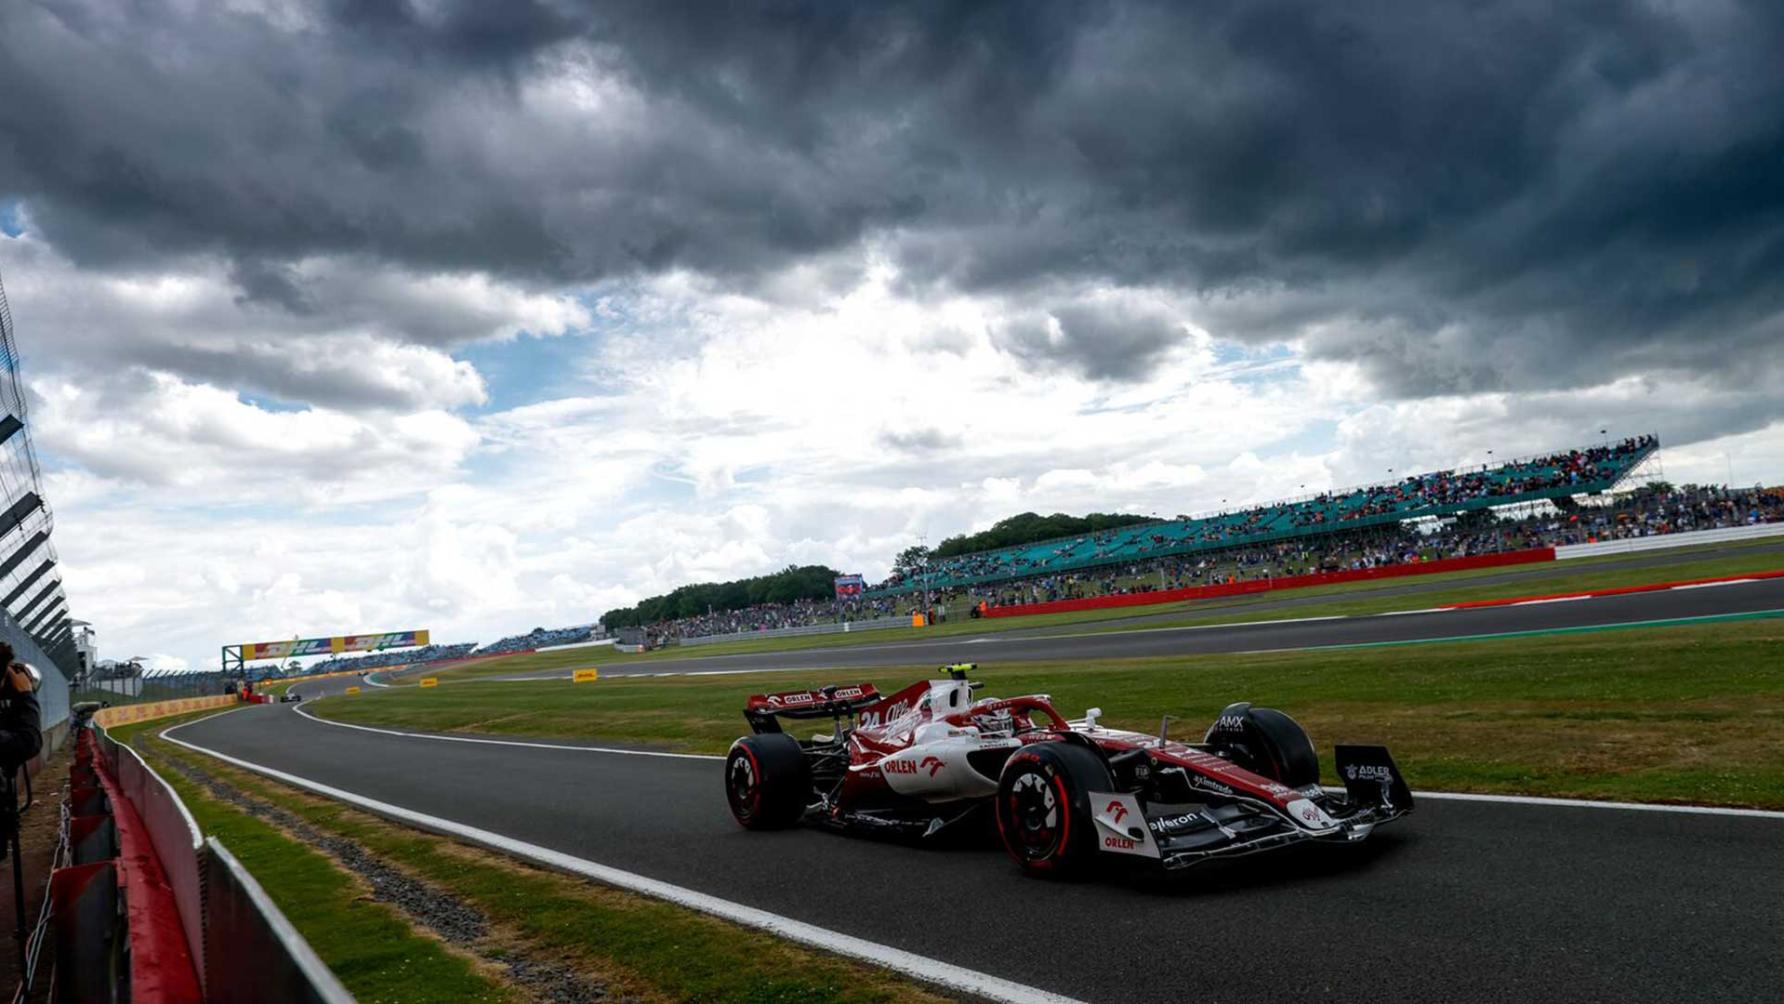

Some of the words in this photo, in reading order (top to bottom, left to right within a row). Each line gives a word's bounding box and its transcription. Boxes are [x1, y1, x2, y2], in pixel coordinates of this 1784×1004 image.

[355, 633, 407, 650] DHL
[266, 640, 323, 656] DHL
[785, 694, 811, 703] ORLEN
[836, 688, 861, 698] ORLEN
[861, 711, 880, 728] 24
[1219, 716, 1244, 728] AMX
[884, 760, 918, 774] ORLEN
[1359, 765, 1390, 776] ADLER
[1104, 837, 1137, 849] ORLEN
